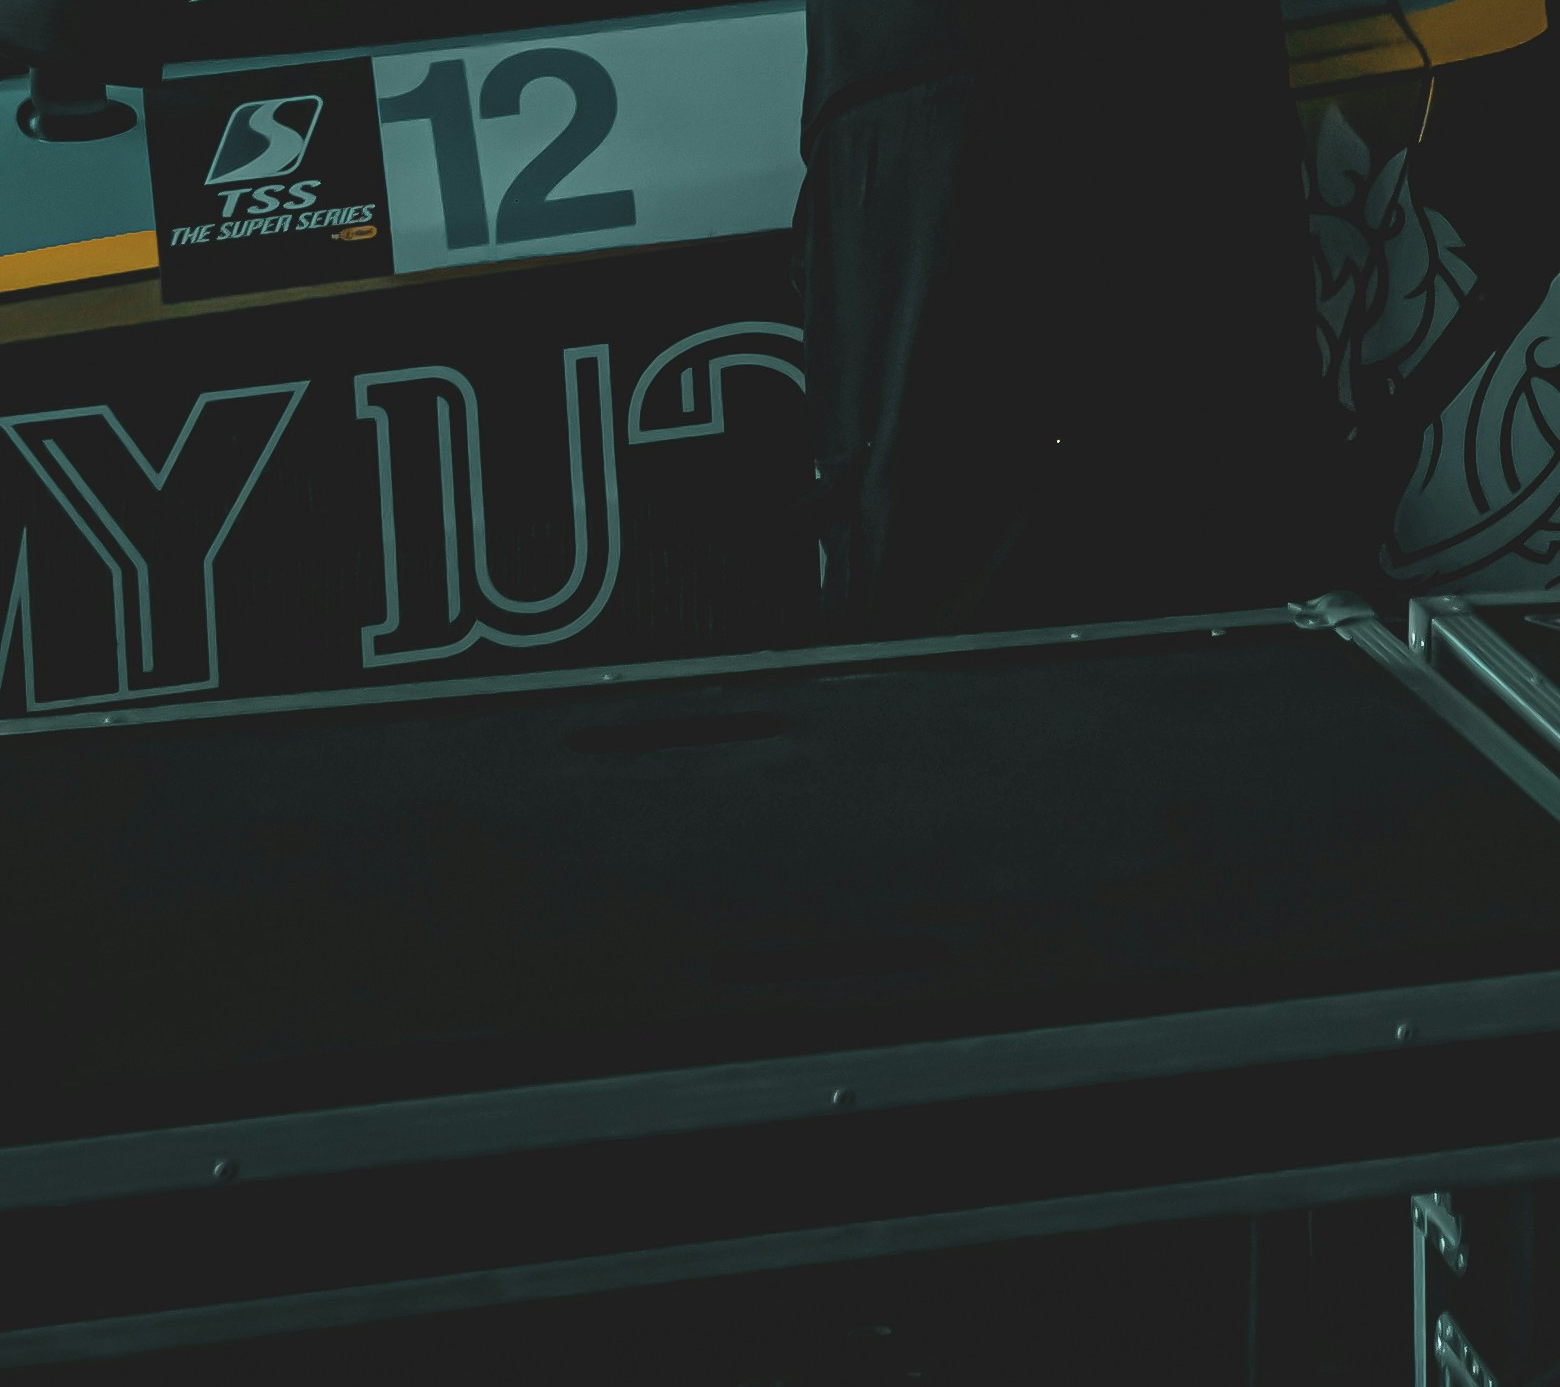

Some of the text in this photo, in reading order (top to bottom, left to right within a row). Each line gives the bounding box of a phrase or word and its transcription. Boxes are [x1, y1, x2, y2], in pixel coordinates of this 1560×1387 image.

[379, 47, 636, 250] 12
[217, 179, 322, 218] TSS
[170, 203, 376, 247] THE SUPER SERIES
